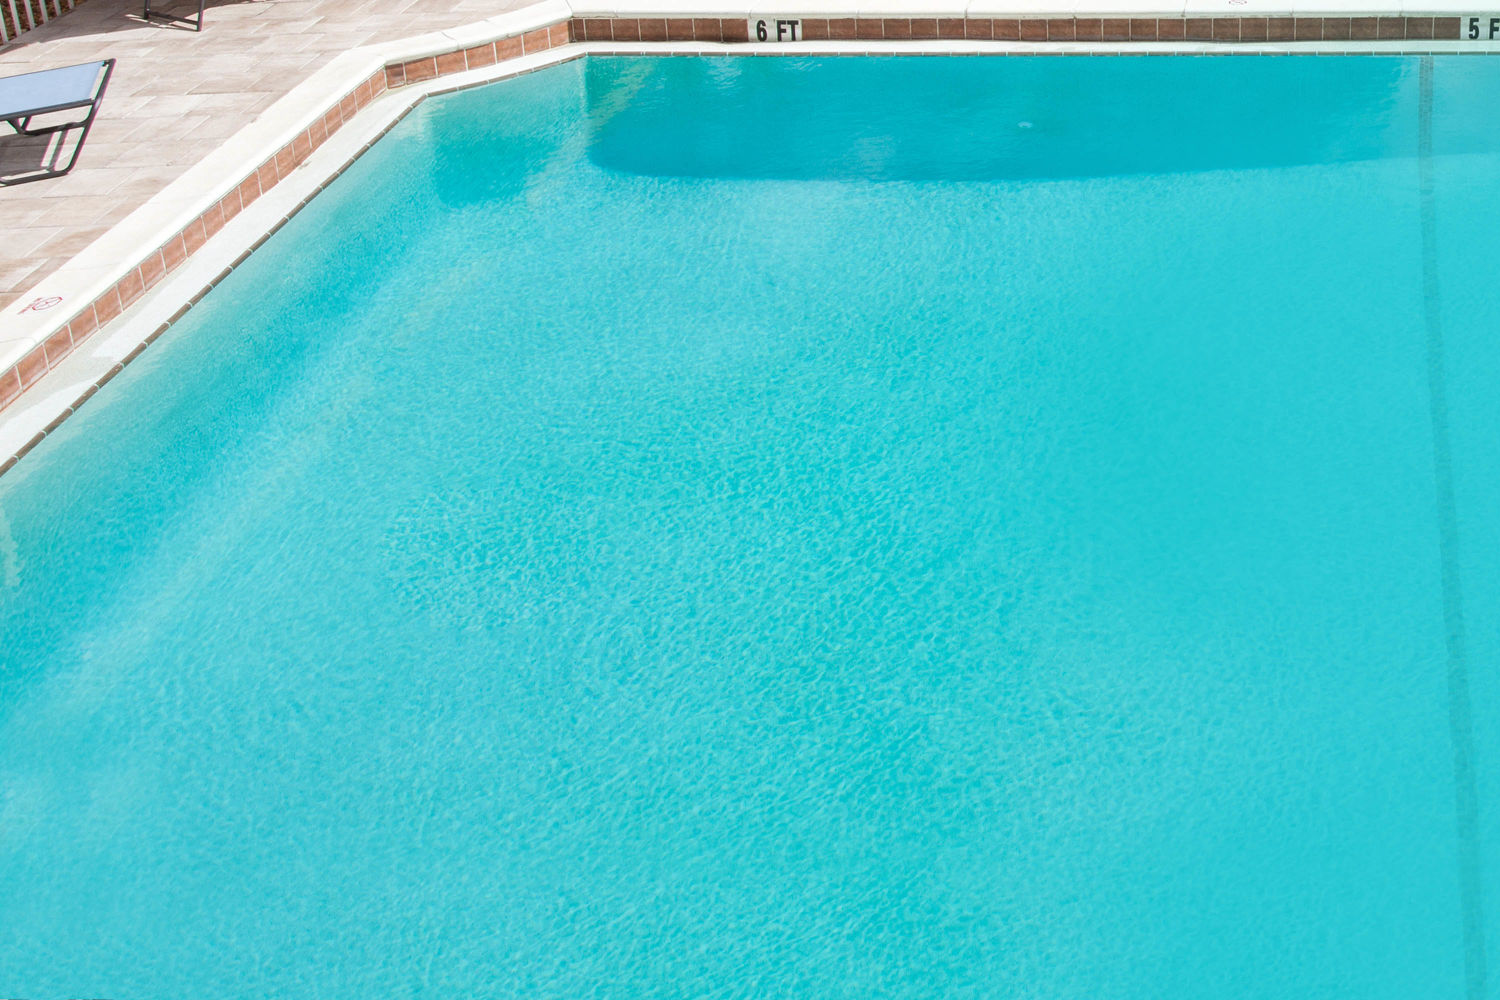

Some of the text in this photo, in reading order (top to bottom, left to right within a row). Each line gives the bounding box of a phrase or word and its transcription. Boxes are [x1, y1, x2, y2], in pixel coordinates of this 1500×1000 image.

[756, 19, 799, 42] 6 FT
[1468, 17, 1480, 40] 5
